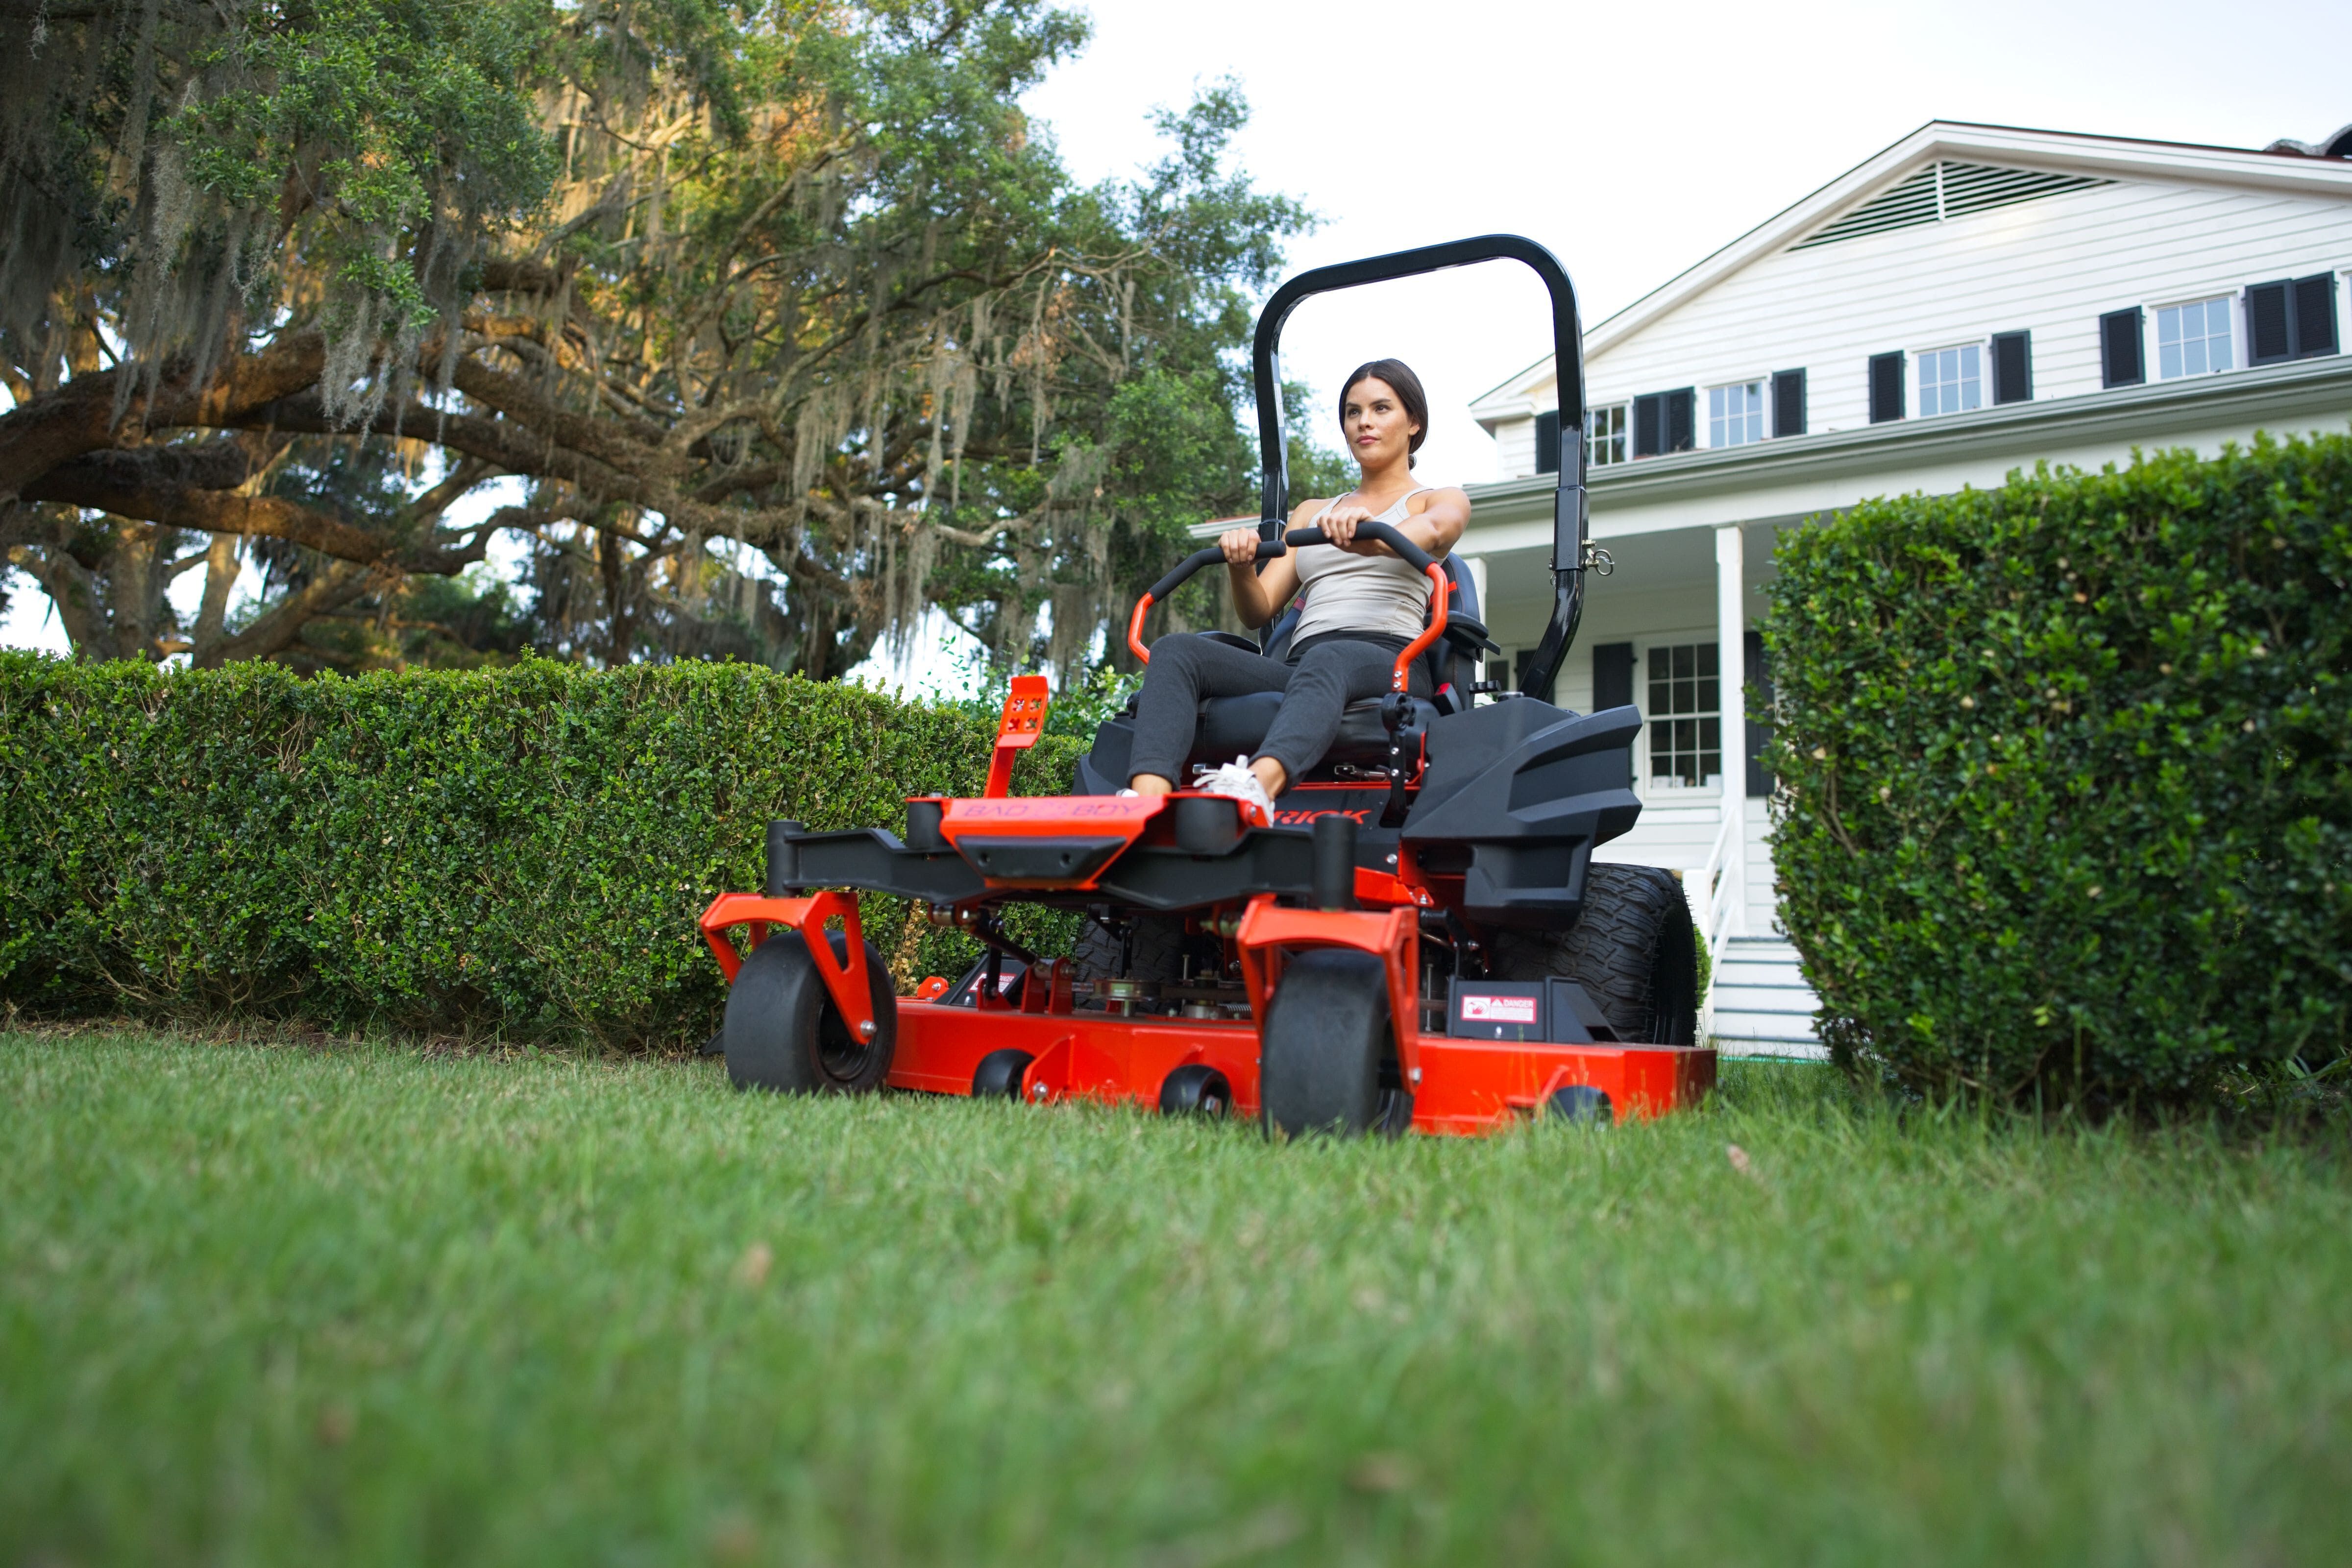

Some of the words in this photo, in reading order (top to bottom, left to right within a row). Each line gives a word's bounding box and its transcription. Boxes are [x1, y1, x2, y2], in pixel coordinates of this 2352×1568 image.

[964, 804, 1029, 817] BAD
[1072, 803, 1144, 816] BOY
[1503, 998, 1533, 1008] DANGER
